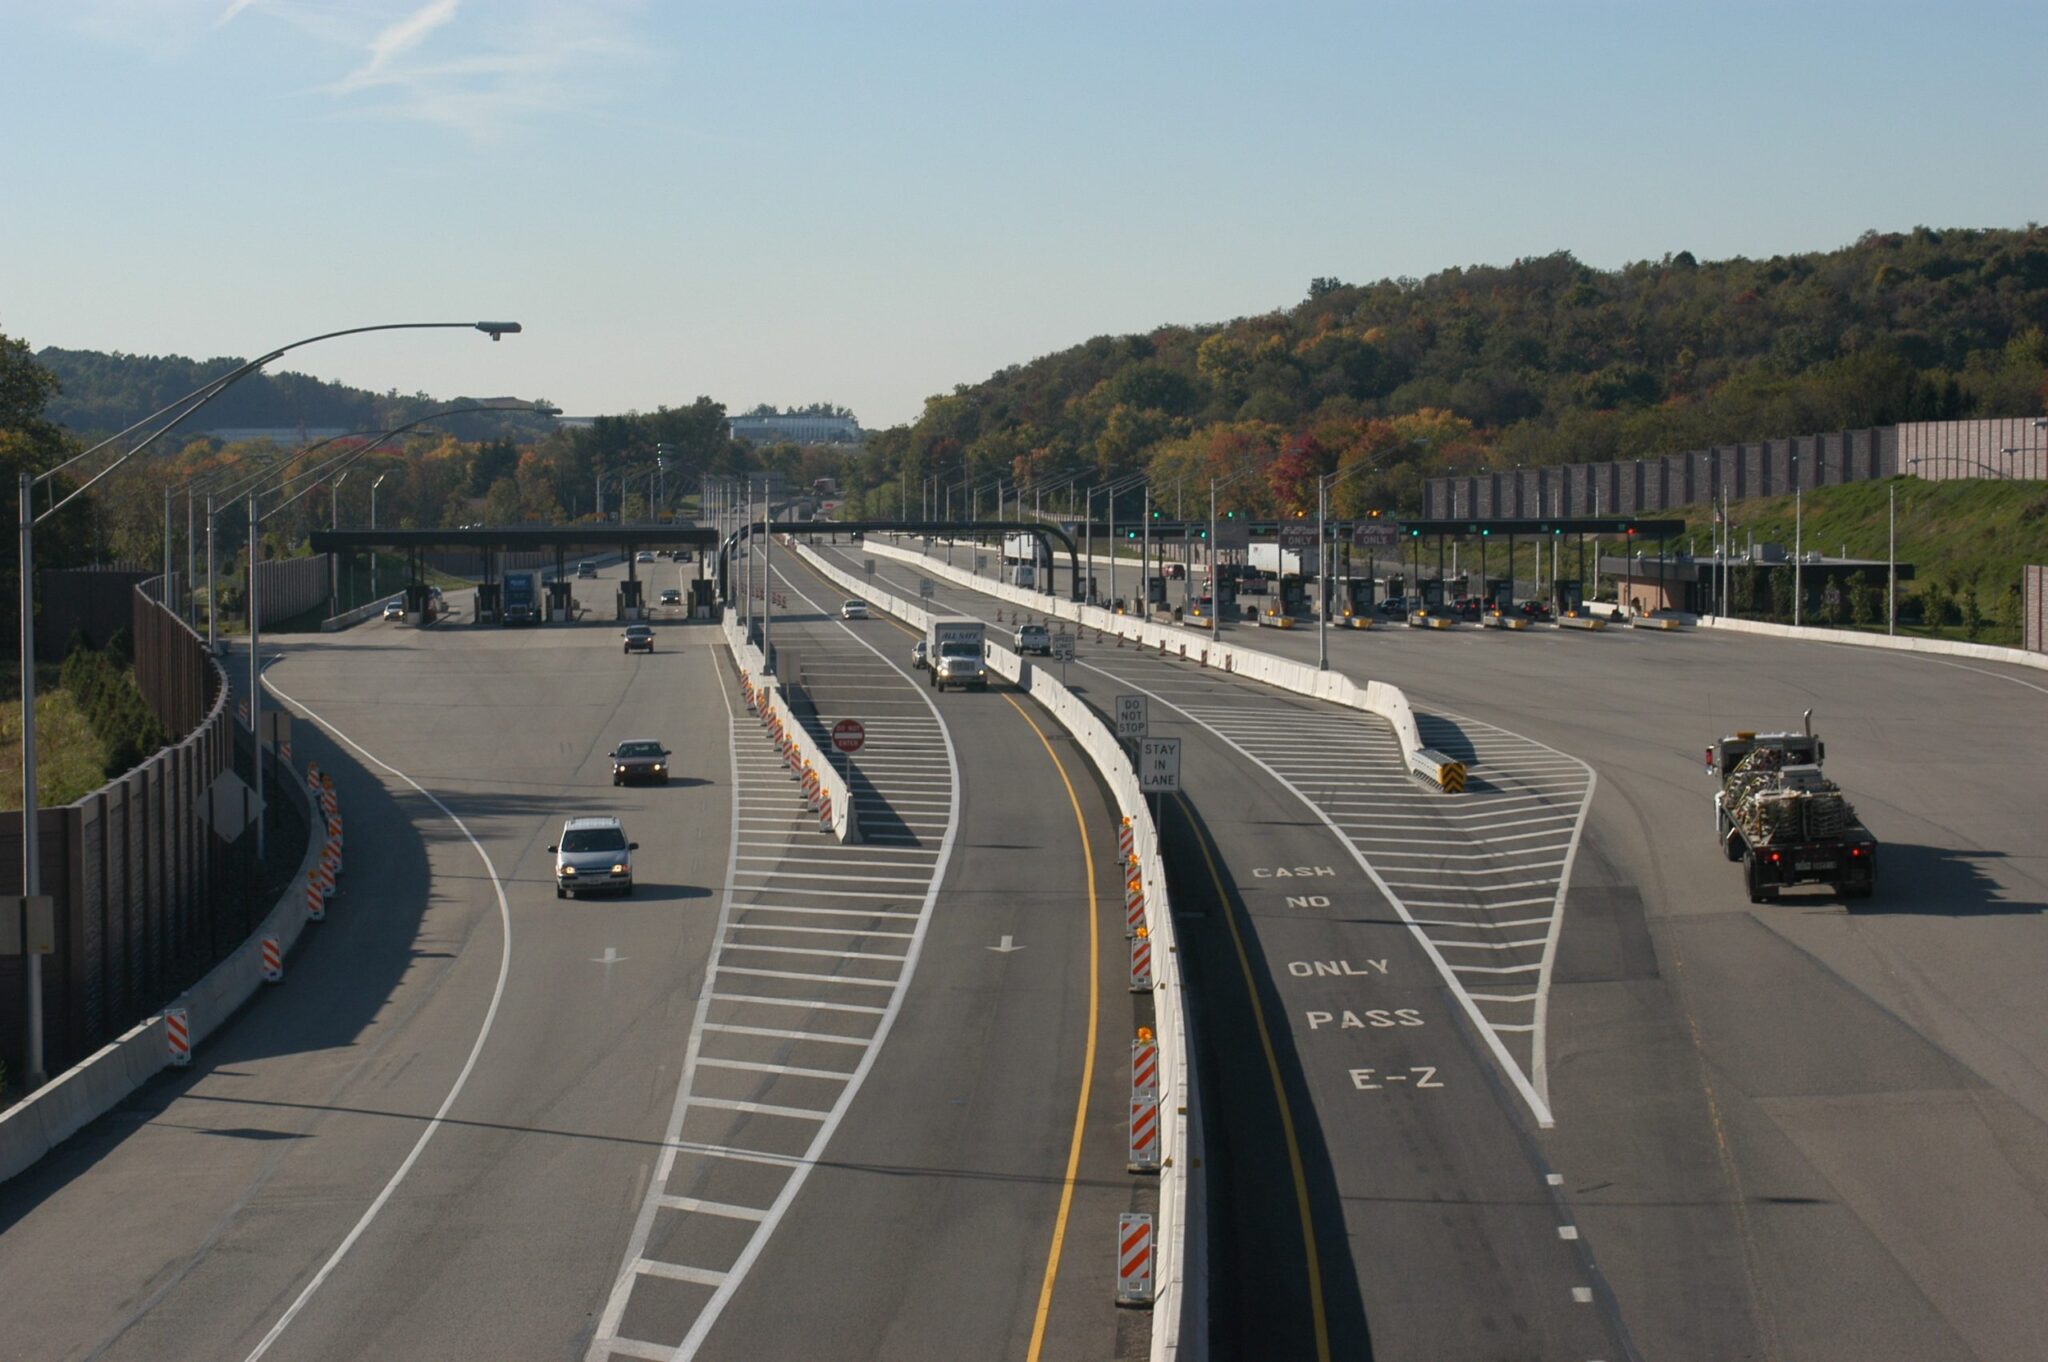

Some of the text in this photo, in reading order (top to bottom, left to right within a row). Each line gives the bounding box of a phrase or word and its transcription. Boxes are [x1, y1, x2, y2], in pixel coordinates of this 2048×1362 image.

[1287, 535, 1312, 545] ONLY
[1363, 535, 1388, 545] ONLY
[1055, 650, 1073, 661] 55
[1125, 700, 1140, 710] DO
[1121, 711, 1142, 721] NOT
[1119, 722, 1145, 733] STOP
[1145, 744, 1176, 755] STAY
[1154, 760, 1166, 770] IN
[1144, 775, 1175, 786] LANE
[1252, 866, 1336, 878] CASH
[1286, 896, 1331, 908] NO
[1287, 959, 1389, 977] ONLY
[1306, 1009, 1425, 1030] PASS
[1348, 1066, 1445, 1090] E-Z
